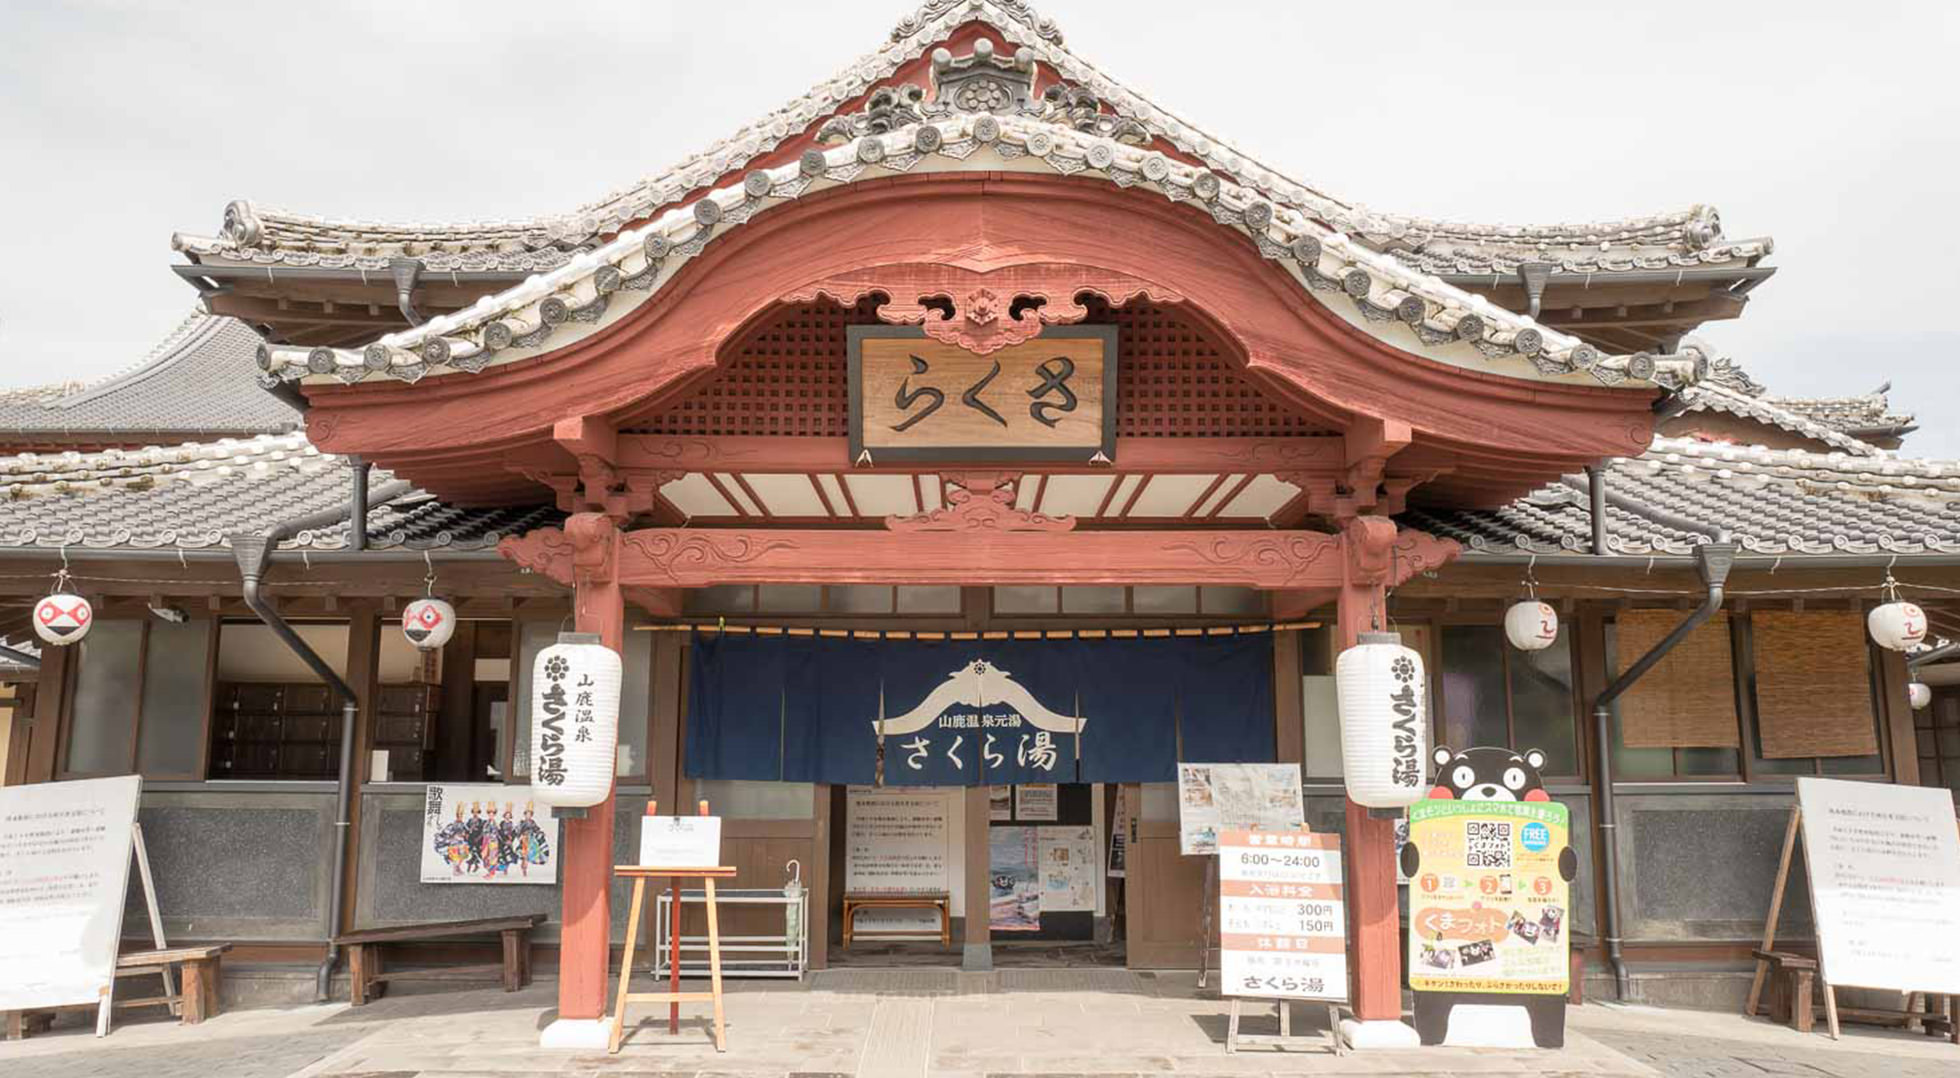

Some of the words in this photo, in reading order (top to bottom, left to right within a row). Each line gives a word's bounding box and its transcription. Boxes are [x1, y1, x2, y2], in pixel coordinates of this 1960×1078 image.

[574, 673, 595, 743] 山鹿温泉
[938, 714, 1022, 729] 山鹿温泉元湯
[538, 683, 568, 786] さくら湯
[1390, 684, 1420, 788] さくら湯
[901, 731, 1057, 772] さくら湯
[1524, 828, 1547, 841] FREE
[1297, 904, 1333, 916] 300円
[1299, 920, 1334, 932] 150円
[1425, 912, 1500, 933] くまフォト
[1243, 975, 1326, 993] さくら湯
